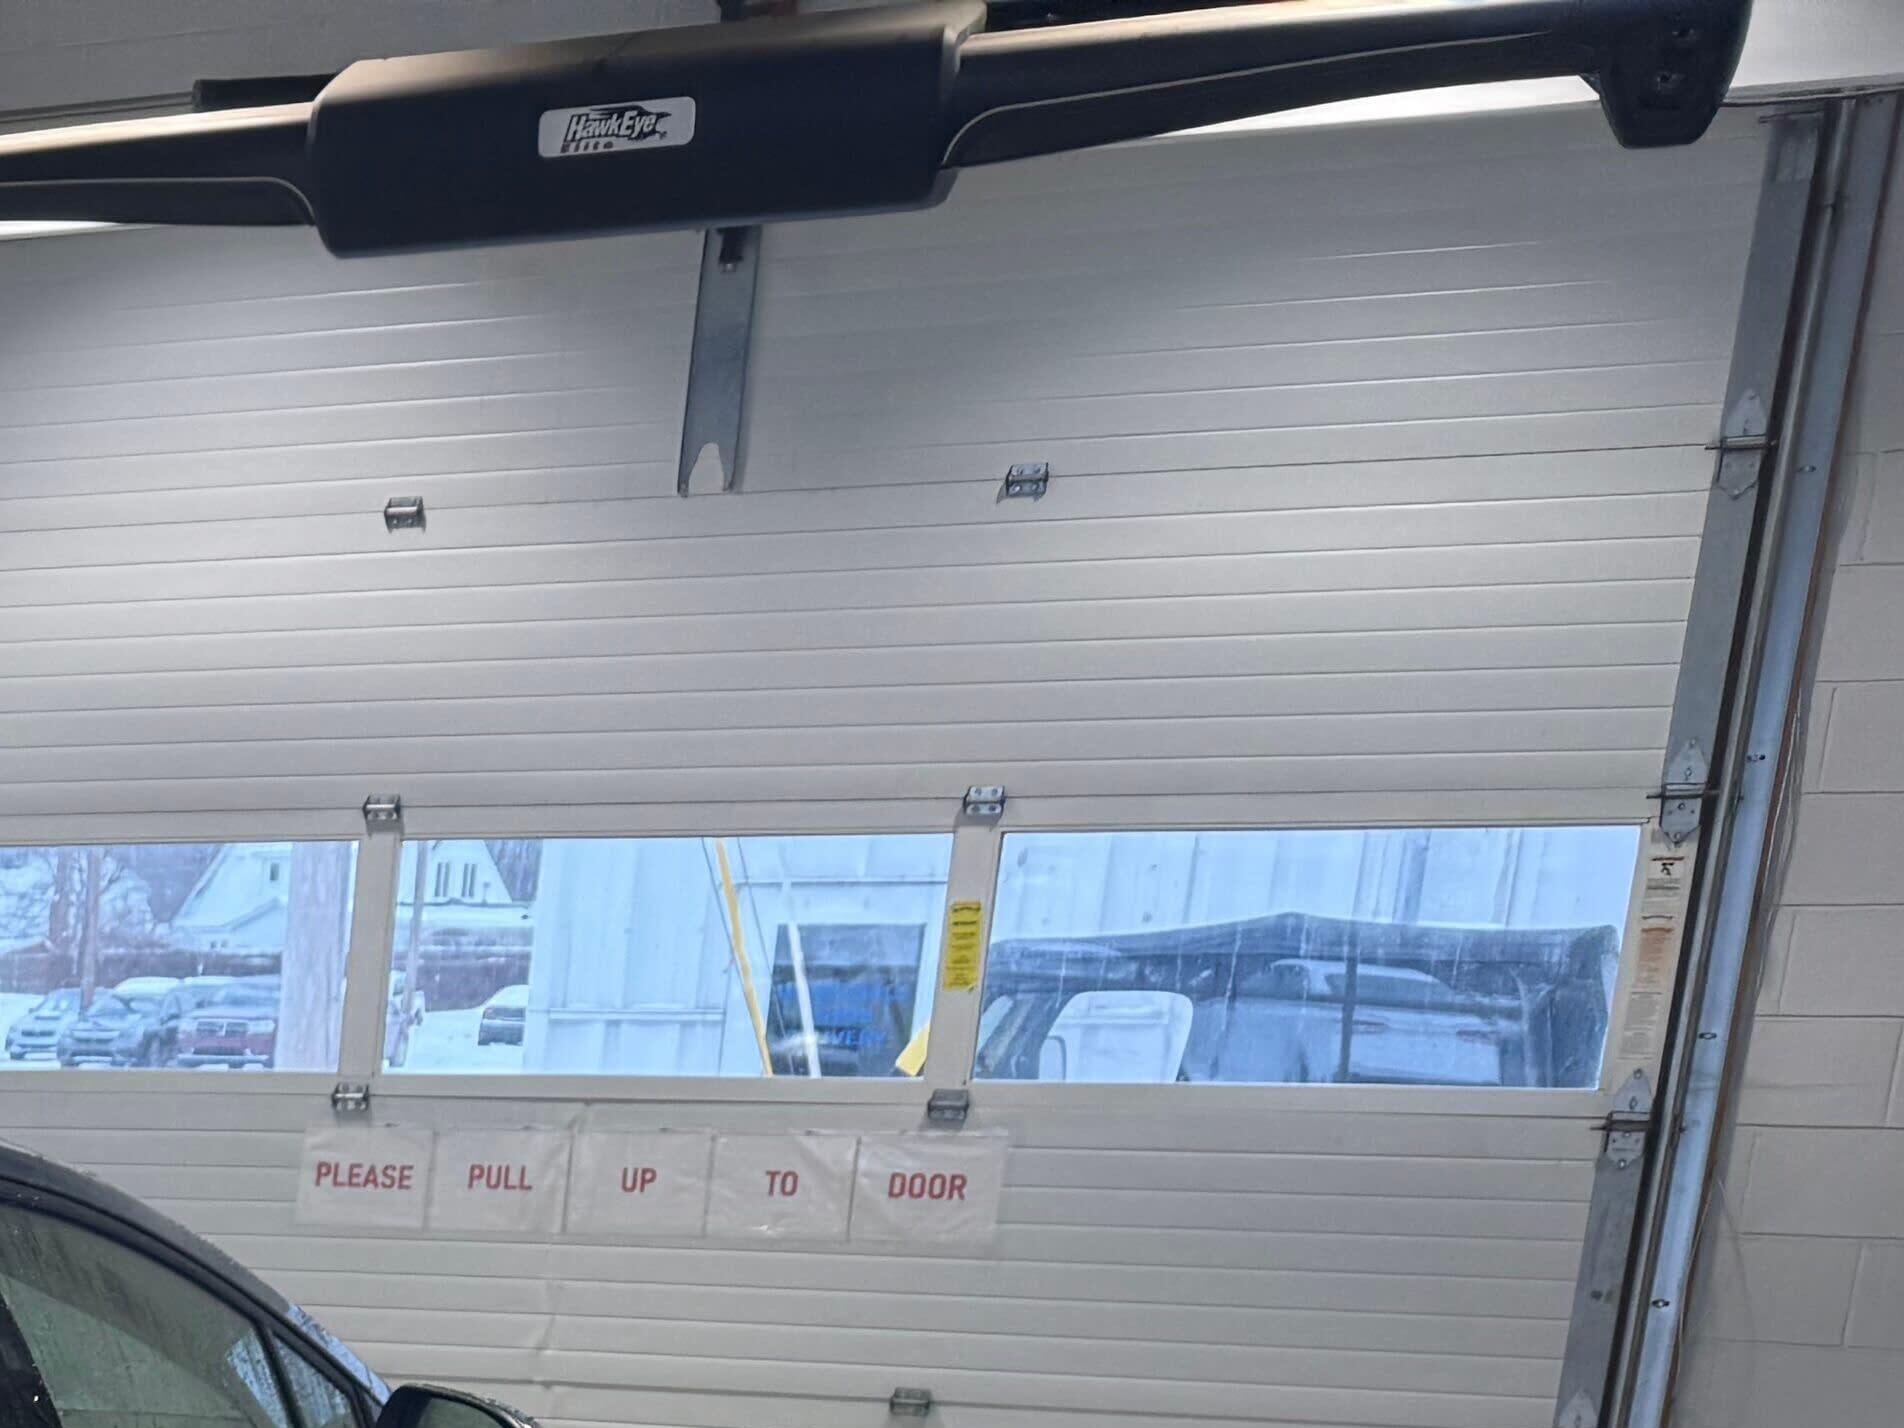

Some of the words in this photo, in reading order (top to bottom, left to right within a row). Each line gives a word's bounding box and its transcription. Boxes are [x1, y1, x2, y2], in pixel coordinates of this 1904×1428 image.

[565, 110, 658, 141] HawkEye
[314, 1161, 414, 1191] PLEASE
[467, 1164, 533, 1192] PULL
[620, 1167, 658, 1194] UP
[764, 1169, 799, 1198] TO
[887, 1171, 968, 1202] DOOR
